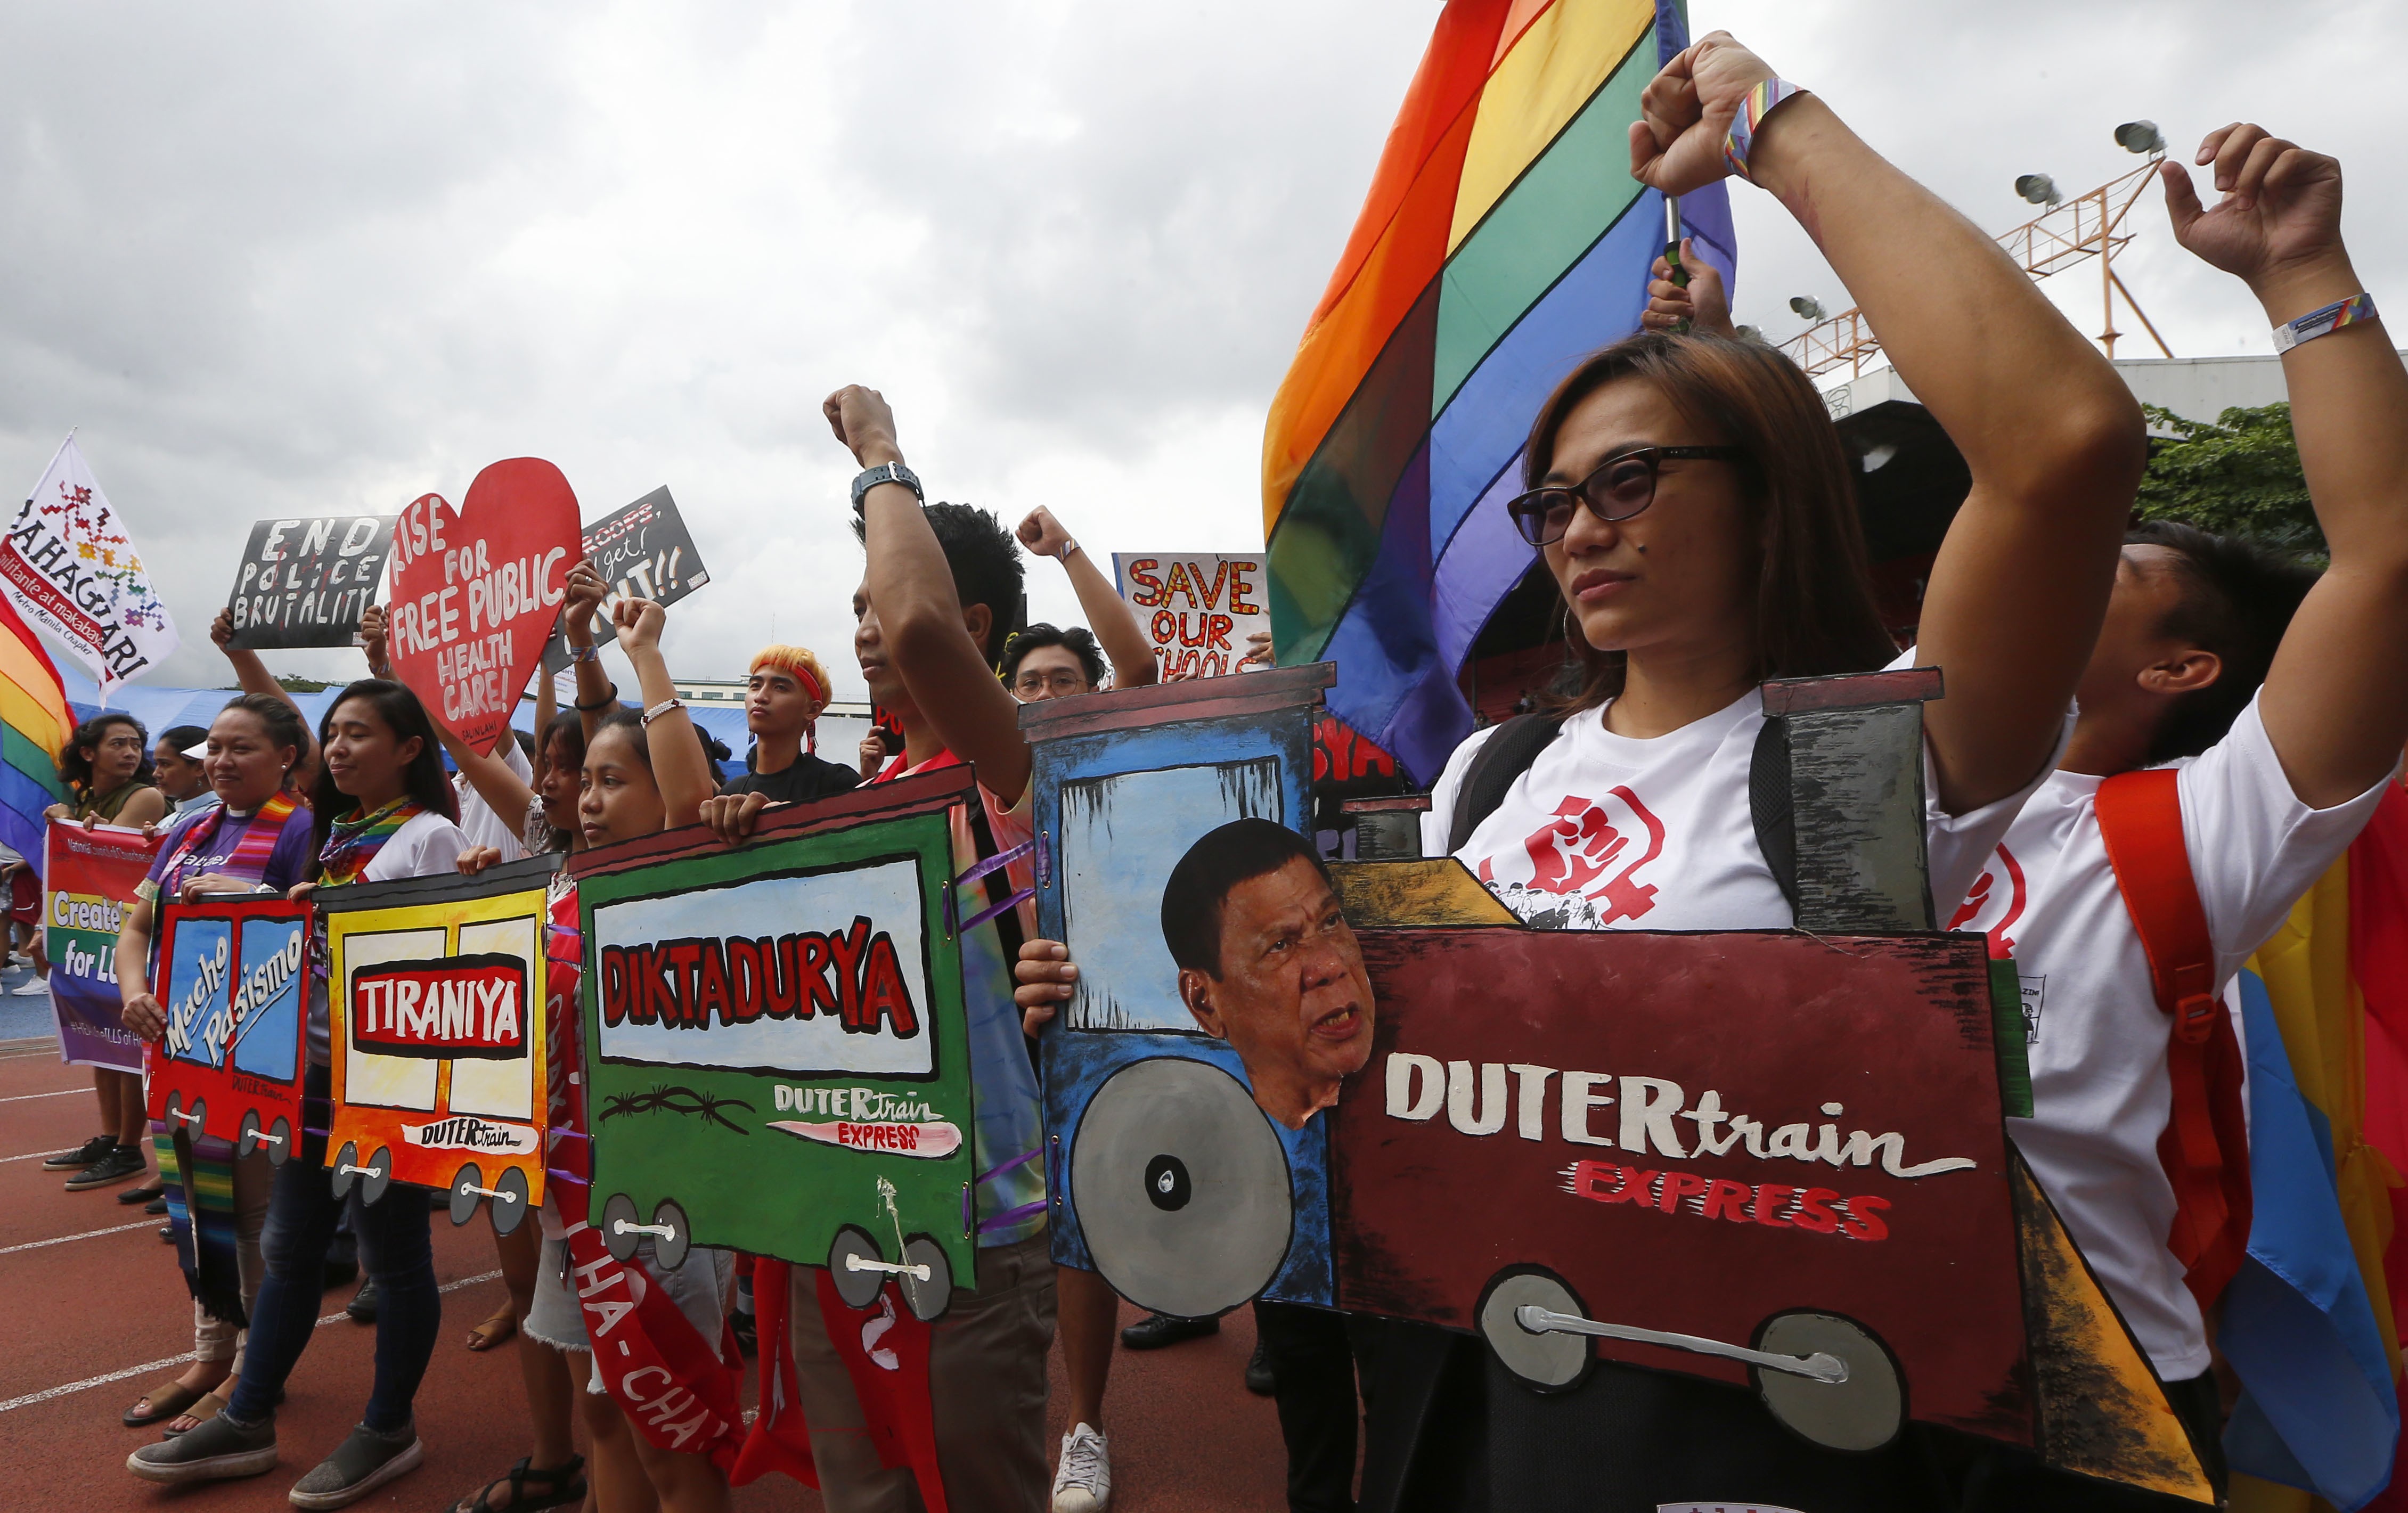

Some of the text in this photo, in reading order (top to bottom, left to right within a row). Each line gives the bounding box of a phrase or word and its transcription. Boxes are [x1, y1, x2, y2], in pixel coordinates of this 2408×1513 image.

[261, 518, 380, 561] END
[391, 496, 446, 586] RISE
[444, 538, 490, 585] FOR
[39, 592, 57, 606] at
[239, 555, 380, 595] POLICE
[1129, 558, 1260, 615] SAVE
[12, 591, 93, 655] Metro Manila Chapter
[233, 587, 374, 630] BRUTALITY
[393, 546, 567, 660] FREE PUBLIC
[1151, 609, 1234, 651] OUR
[437, 629, 513, 686] HEALTH
[444, 667, 509, 722] CARE!
[54, 889, 121, 933] Create
[65, 938, 96, 978] for
[601, 915, 920, 1040] DIKTADURYA
[166, 935, 228, 1060] Macho
[203, 929, 302, 1069] Pasismo
[359, 976, 520, 1043] TIRANIYA
[232, 1075, 293, 1107] DUTERtrain
[774, 1084, 945, 1122] DUTERtrain
[1385, 1051, 1977, 1178] DUTERtrain
[421, 1118, 523, 1147] DUTERtrain
[838, 1122, 920, 1150] EXPRESS
[1566, 1158, 1891, 1242] EXPRESS
[572, 1229, 709, 1449] HA-CHA
